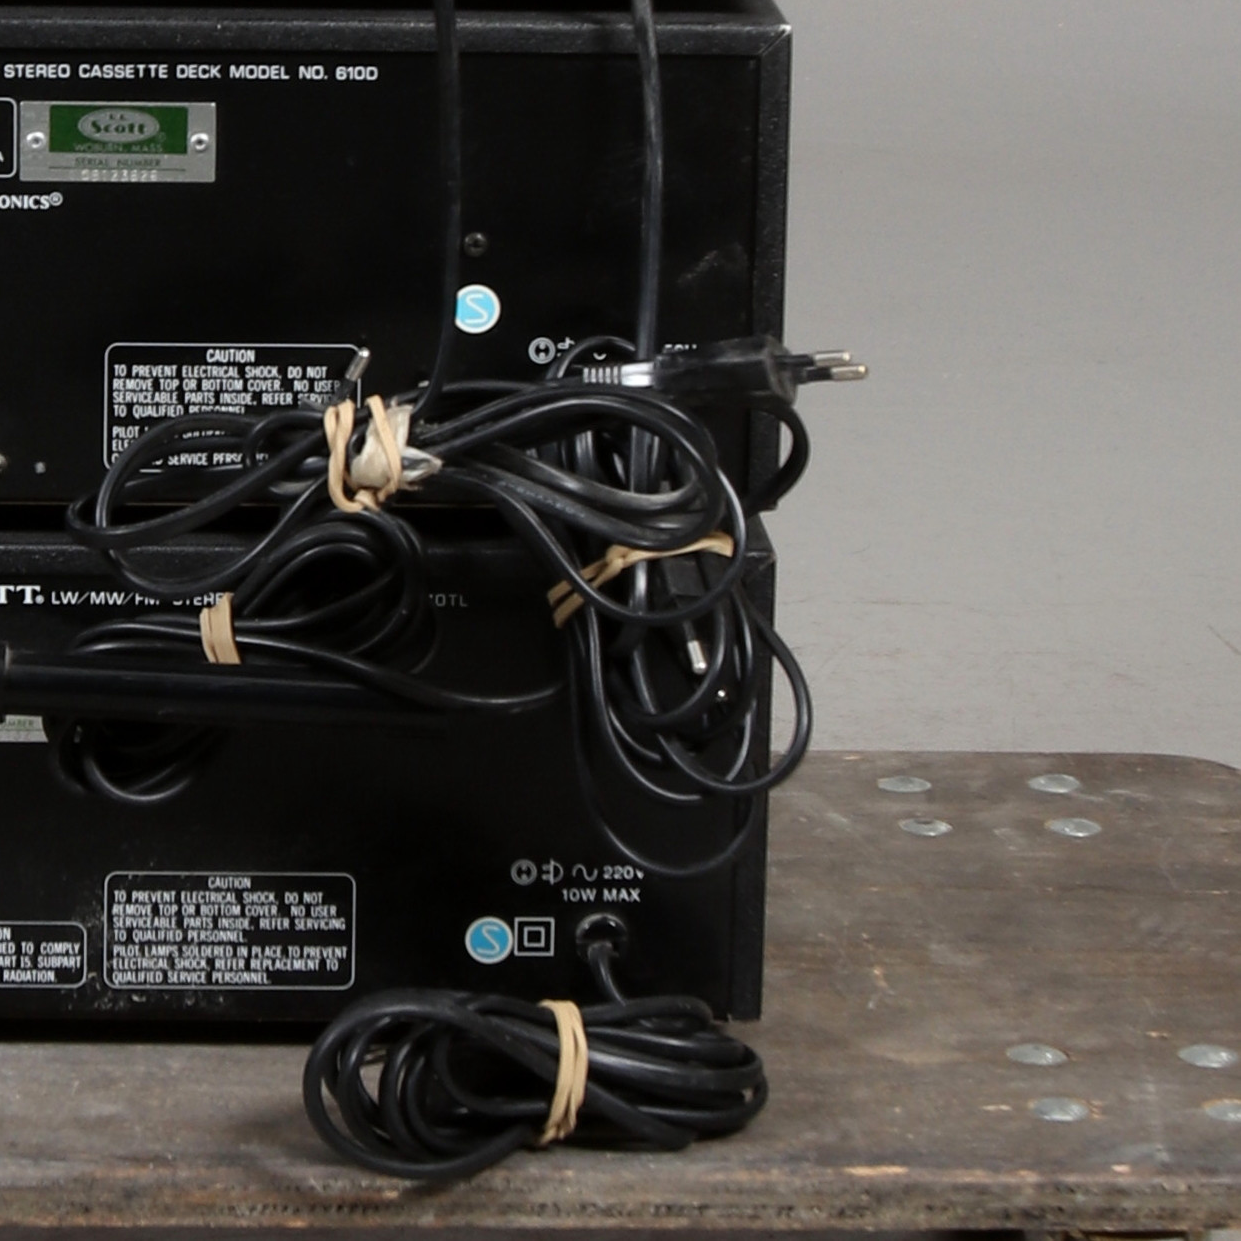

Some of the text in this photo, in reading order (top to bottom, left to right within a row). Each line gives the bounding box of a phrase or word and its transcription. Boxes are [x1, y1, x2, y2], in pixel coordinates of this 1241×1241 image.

[3, 64, 71, 79] STEREO
[78, 64, 169, 79] CASSETTE
[175, 64, 222, 79] DECK
[229, 64, 290, 80] MODEL
[298, 64, 328, 80] NO.
[335, 65, 379, 81] 610D
[90, 117, 146, 135] Scott
[205, 348, 256, 364] CAUTION
[113, 363, 128, 378] TO
[131, 364, 178, 379] PREVENT
[181, 364, 240, 379] ELECTRICAL
[287, 365, 303, 379] DO
[306, 365, 328, 379] NOT
[112, 378, 154, 393] REMOVE
[159, 378, 180, 393] TOP
[182, 378, 198, 393] OR
[201, 378, 244, 393] BOTTOM
[292, 379, 309, 393] NO
[207, 875, 252, 890] CAUTION
[562, 887, 641, 902] 10W MAX
[20, 941, 35, 956] TO
[39, 941, 81, 956] COMPLY
